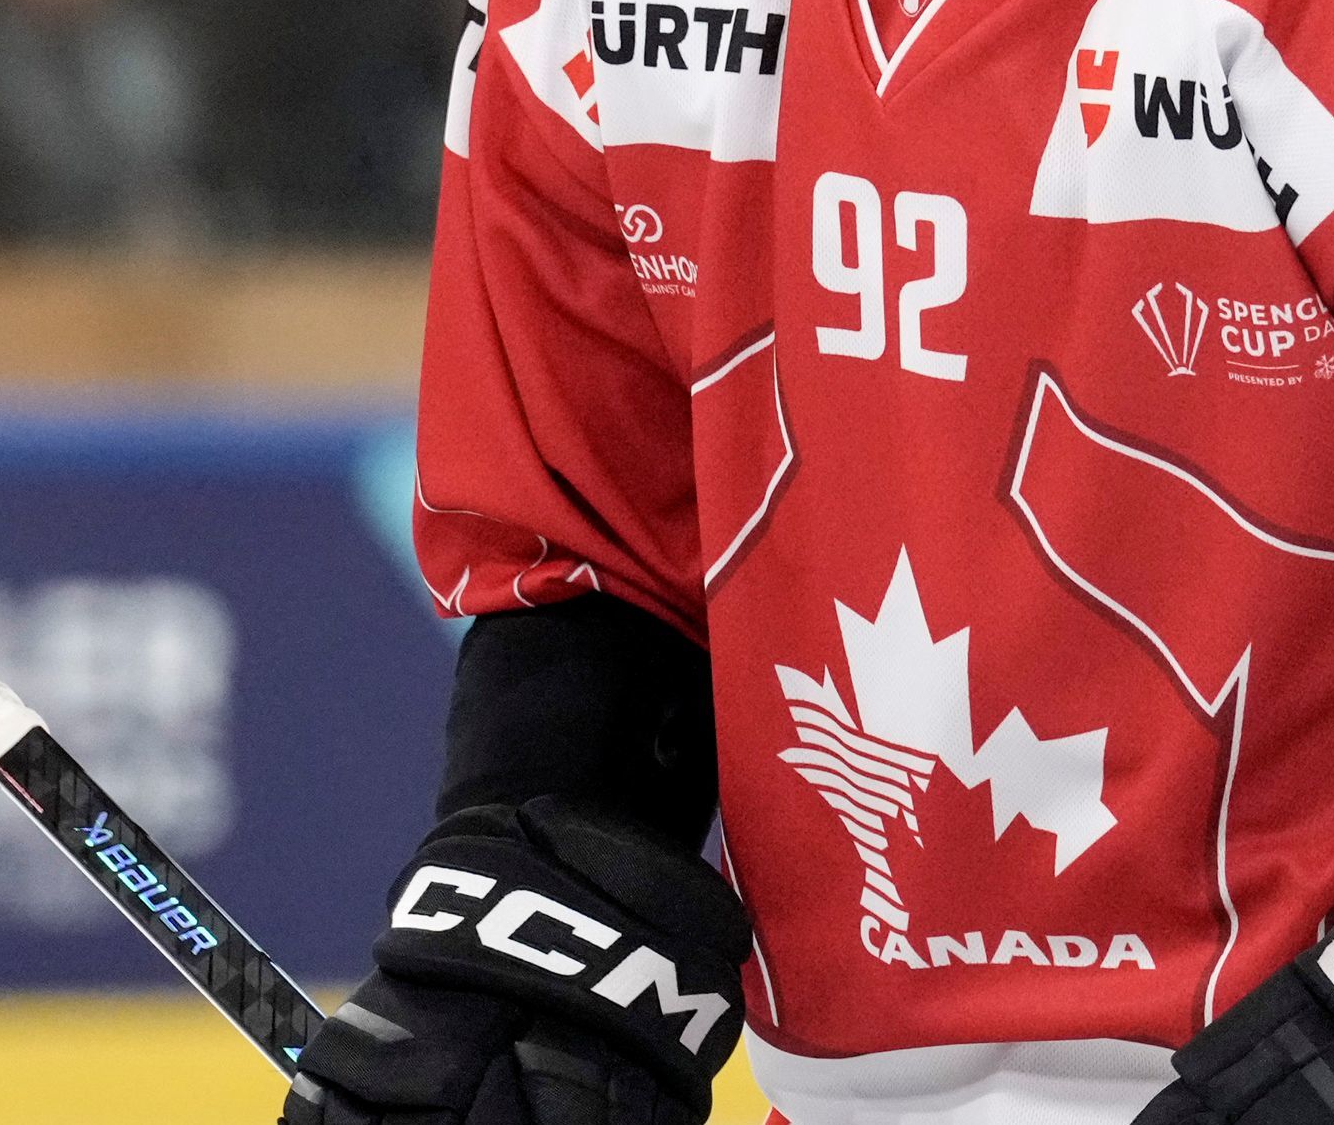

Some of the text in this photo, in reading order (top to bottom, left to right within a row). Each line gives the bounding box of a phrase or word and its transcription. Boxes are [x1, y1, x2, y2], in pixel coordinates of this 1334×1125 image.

[591, 1, 786, 75] ÜRTH
[629, 251, 698, 284] ENHO
[811, 170, 968, 382] 92
[1217, 293, 1329, 325] SPENGL
[1221, 324, 1295, 357] CUP
[1228, 371, 1303, 387] PRESENTED BY
[391, 865, 731, 1056] CCM
[860, 915, 1156, 970] CANADA
